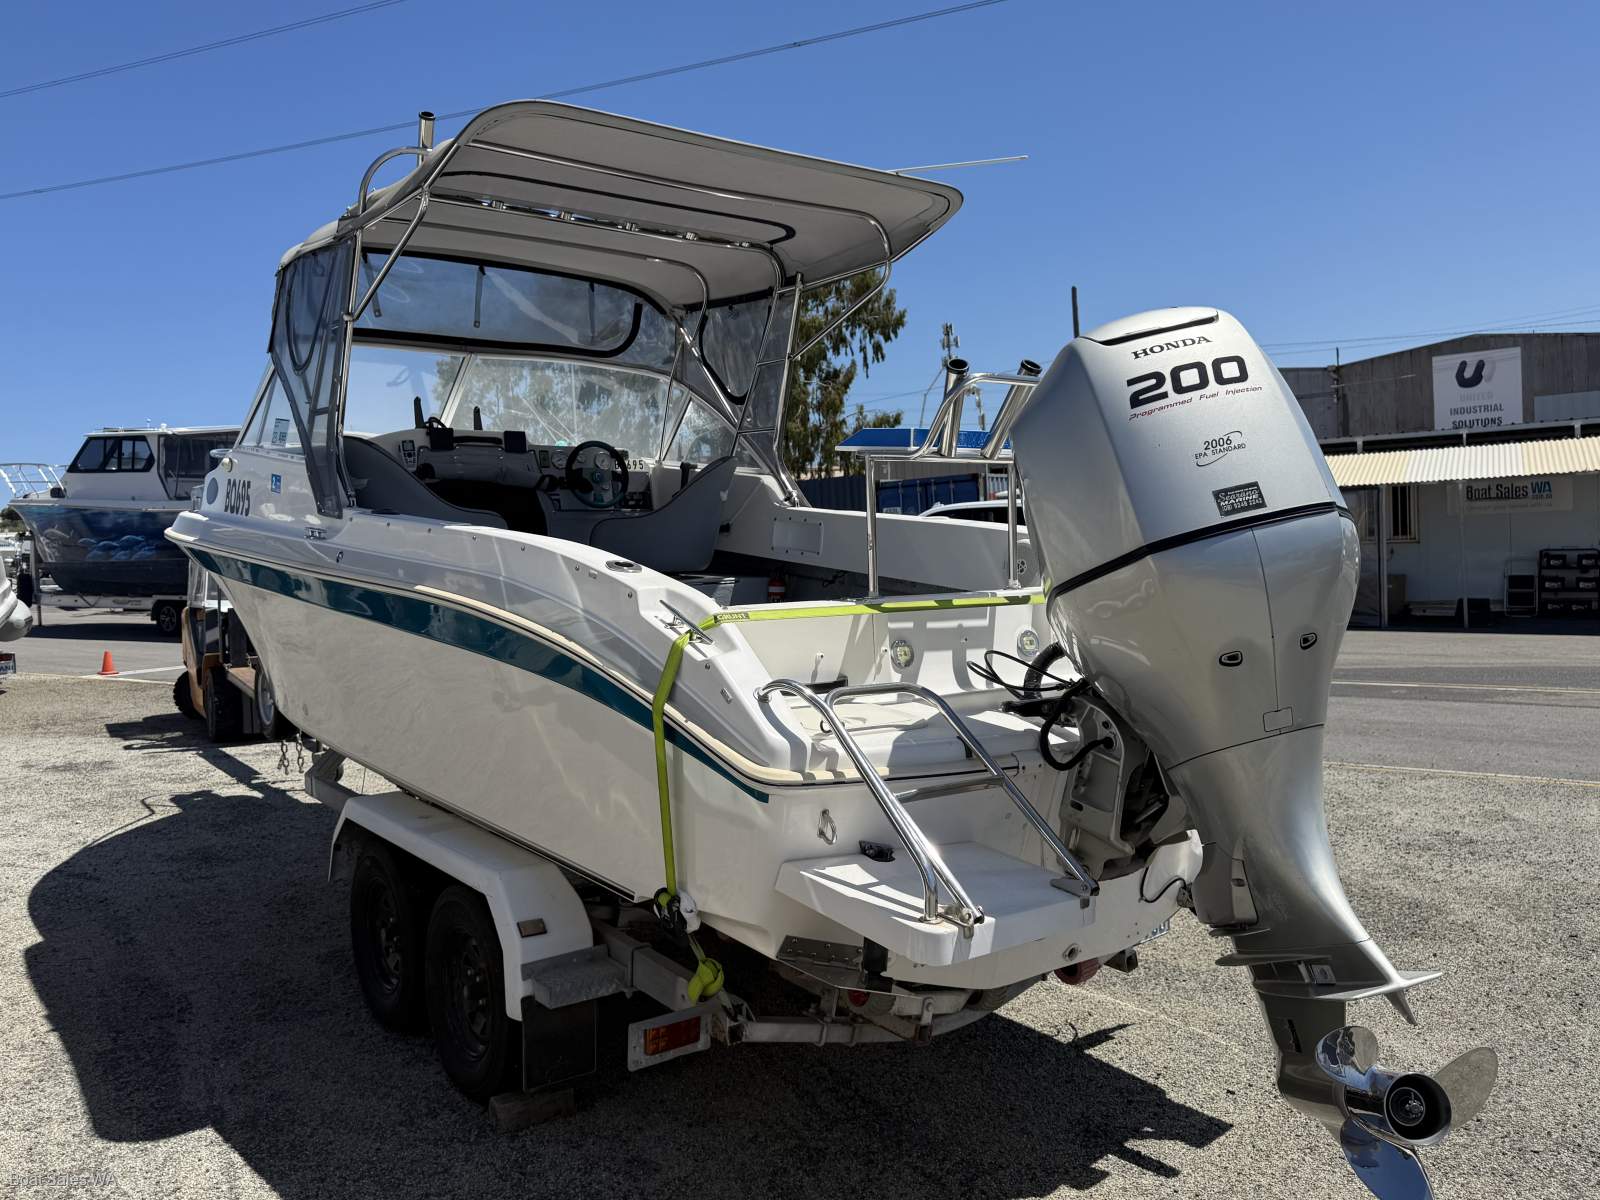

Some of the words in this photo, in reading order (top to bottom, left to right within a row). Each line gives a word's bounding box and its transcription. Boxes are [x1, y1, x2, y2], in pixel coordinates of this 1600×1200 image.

[1131, 336, 1213, 360] HONDA
[1126, 355, 1249, 410] 200
[1129, 397, 1193, 421] Programmed
[1199, 391, 1220, 401] Fuel
[1225, 385, 1263, 397] Injection
[1450, 403, 1504, 416] INDUSTRIAL
[1452, 417, 1503, 430] SOLUTIONS
[1194, 451, 1209, 460] EPA
[1211, 443, 1247, 456] STANDARD
[1203, 436, 1233, 451] 2006
[1466, 484, 1491, 501] Boat
[1496, 483, 1529, 500] Sales
[1531, 481, 1552, 494] WA
